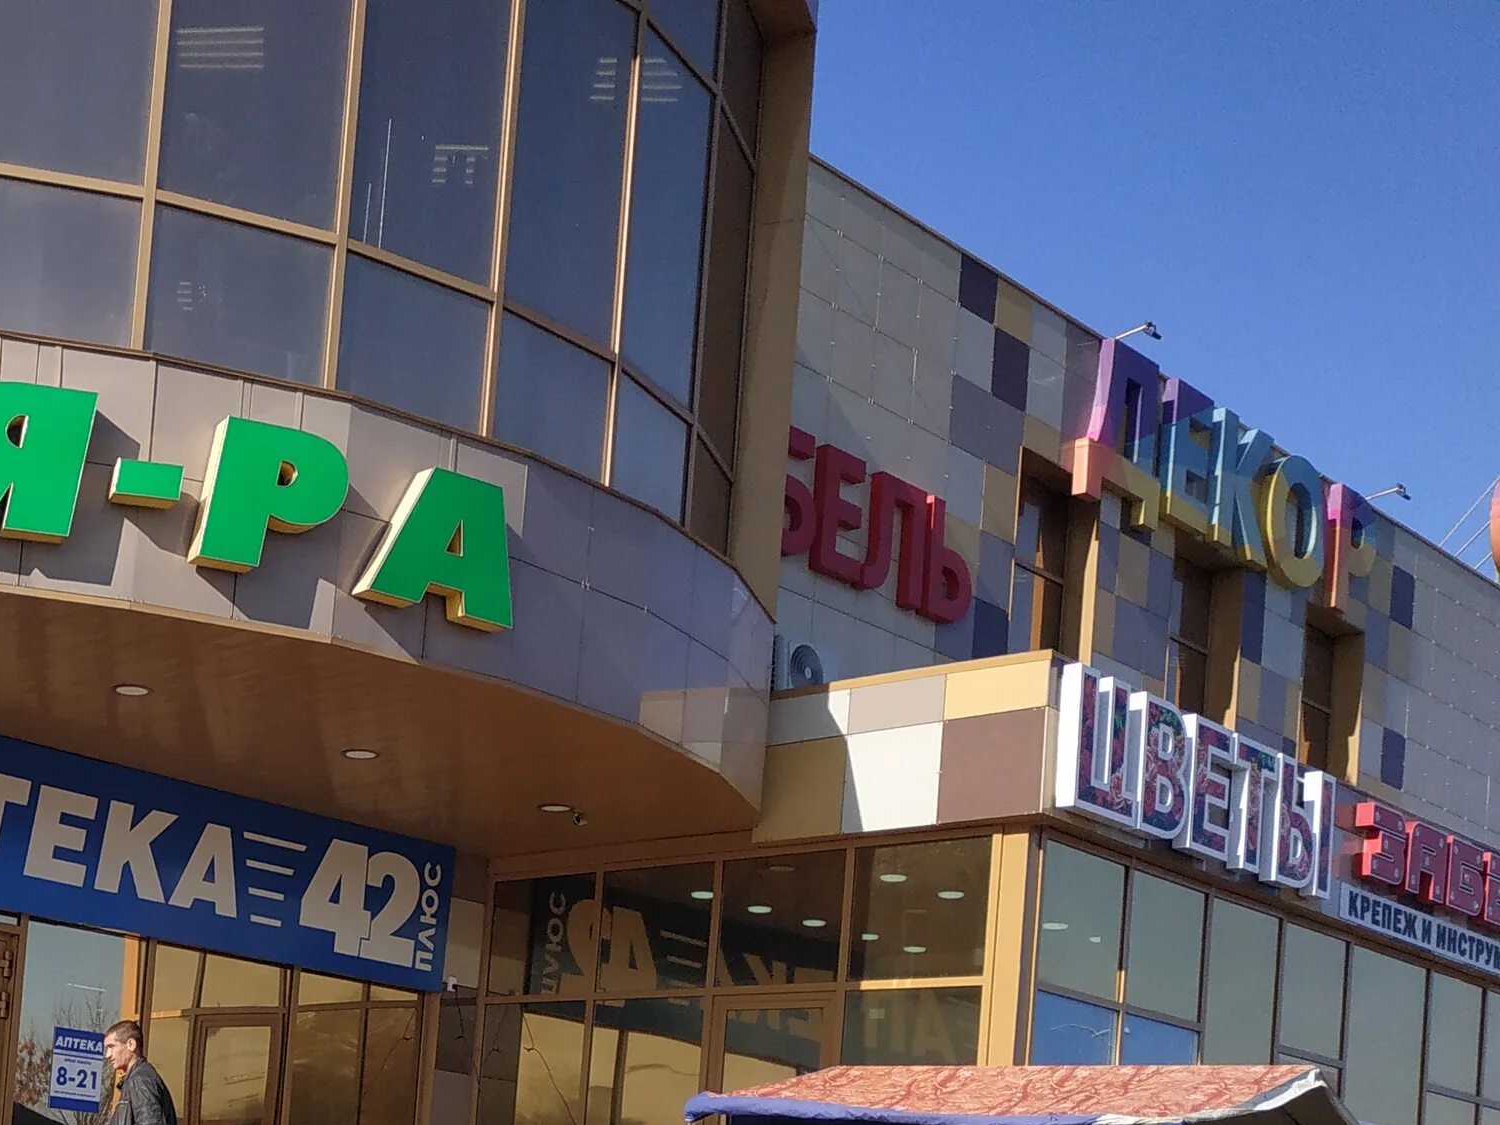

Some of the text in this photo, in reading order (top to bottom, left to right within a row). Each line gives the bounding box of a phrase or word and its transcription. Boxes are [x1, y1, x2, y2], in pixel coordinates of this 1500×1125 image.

[1072, 338, 1377, 612] ДЕКОР
[1056, 662, 1337, 898] ЦВЕТЫ
[299, 837, 424, 968] 42
[414, 861, 443, 973] ПЛЮС
[1348, 889, 1419, 941] КРЕПЕЖ
[1421, 917, 1433, 946] И
[55, 1035, 104, 1053] АПТЕКА
[56, 1066, 97, 1090] 8-21
